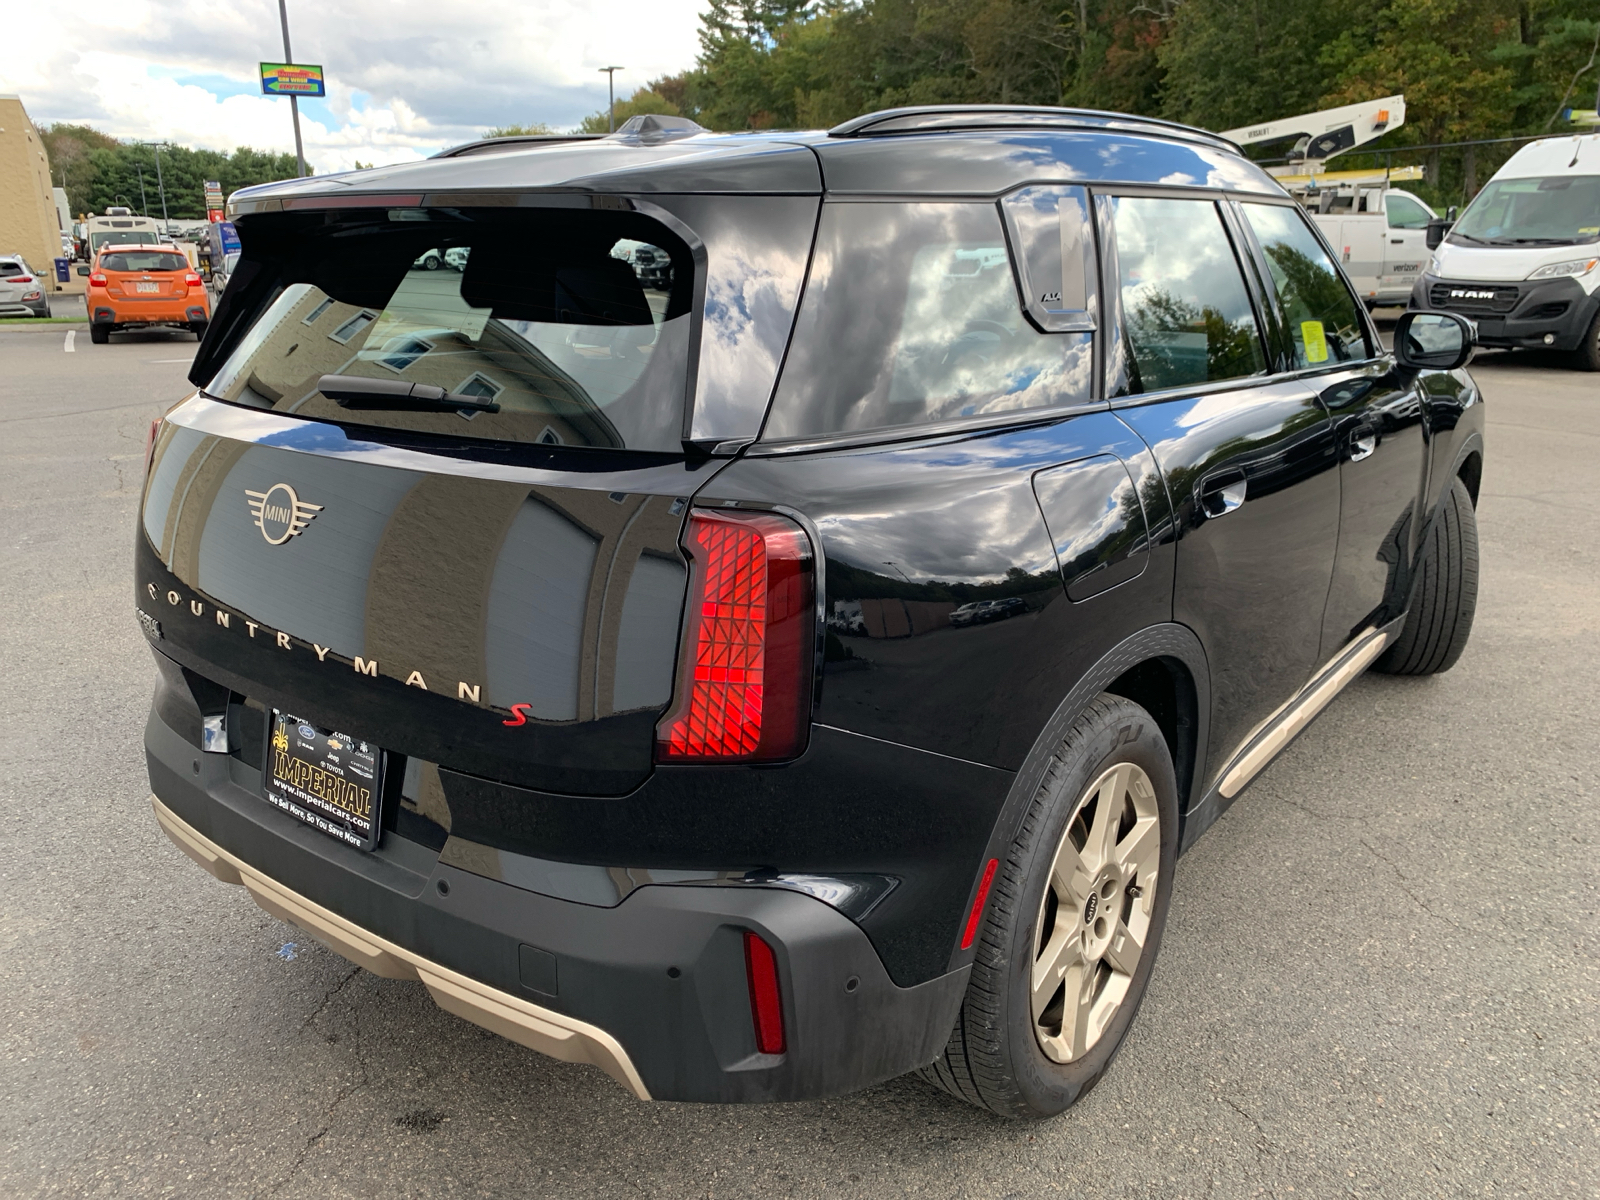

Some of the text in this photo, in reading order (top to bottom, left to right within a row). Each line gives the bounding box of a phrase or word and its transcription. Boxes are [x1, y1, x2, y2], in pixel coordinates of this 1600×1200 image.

[1393, 263, 1418, 272] verizon
[1451, 289, 1495, 299] RAM
[264, 504, 291, 524] MINI
[147, 581, 481, 703] COUNTRYMAN
[327, 751, 340, 763] Jeep
[326, 763, 344, 776] TOYOTA
[274, 750, 371, 820] IMPERIAL
[273, 778, 371, 830] www.imperialcars.com
[269, 793, 361, 846] We Sell More, So You Save More
[1087, 896, 1097, 921] MINI
